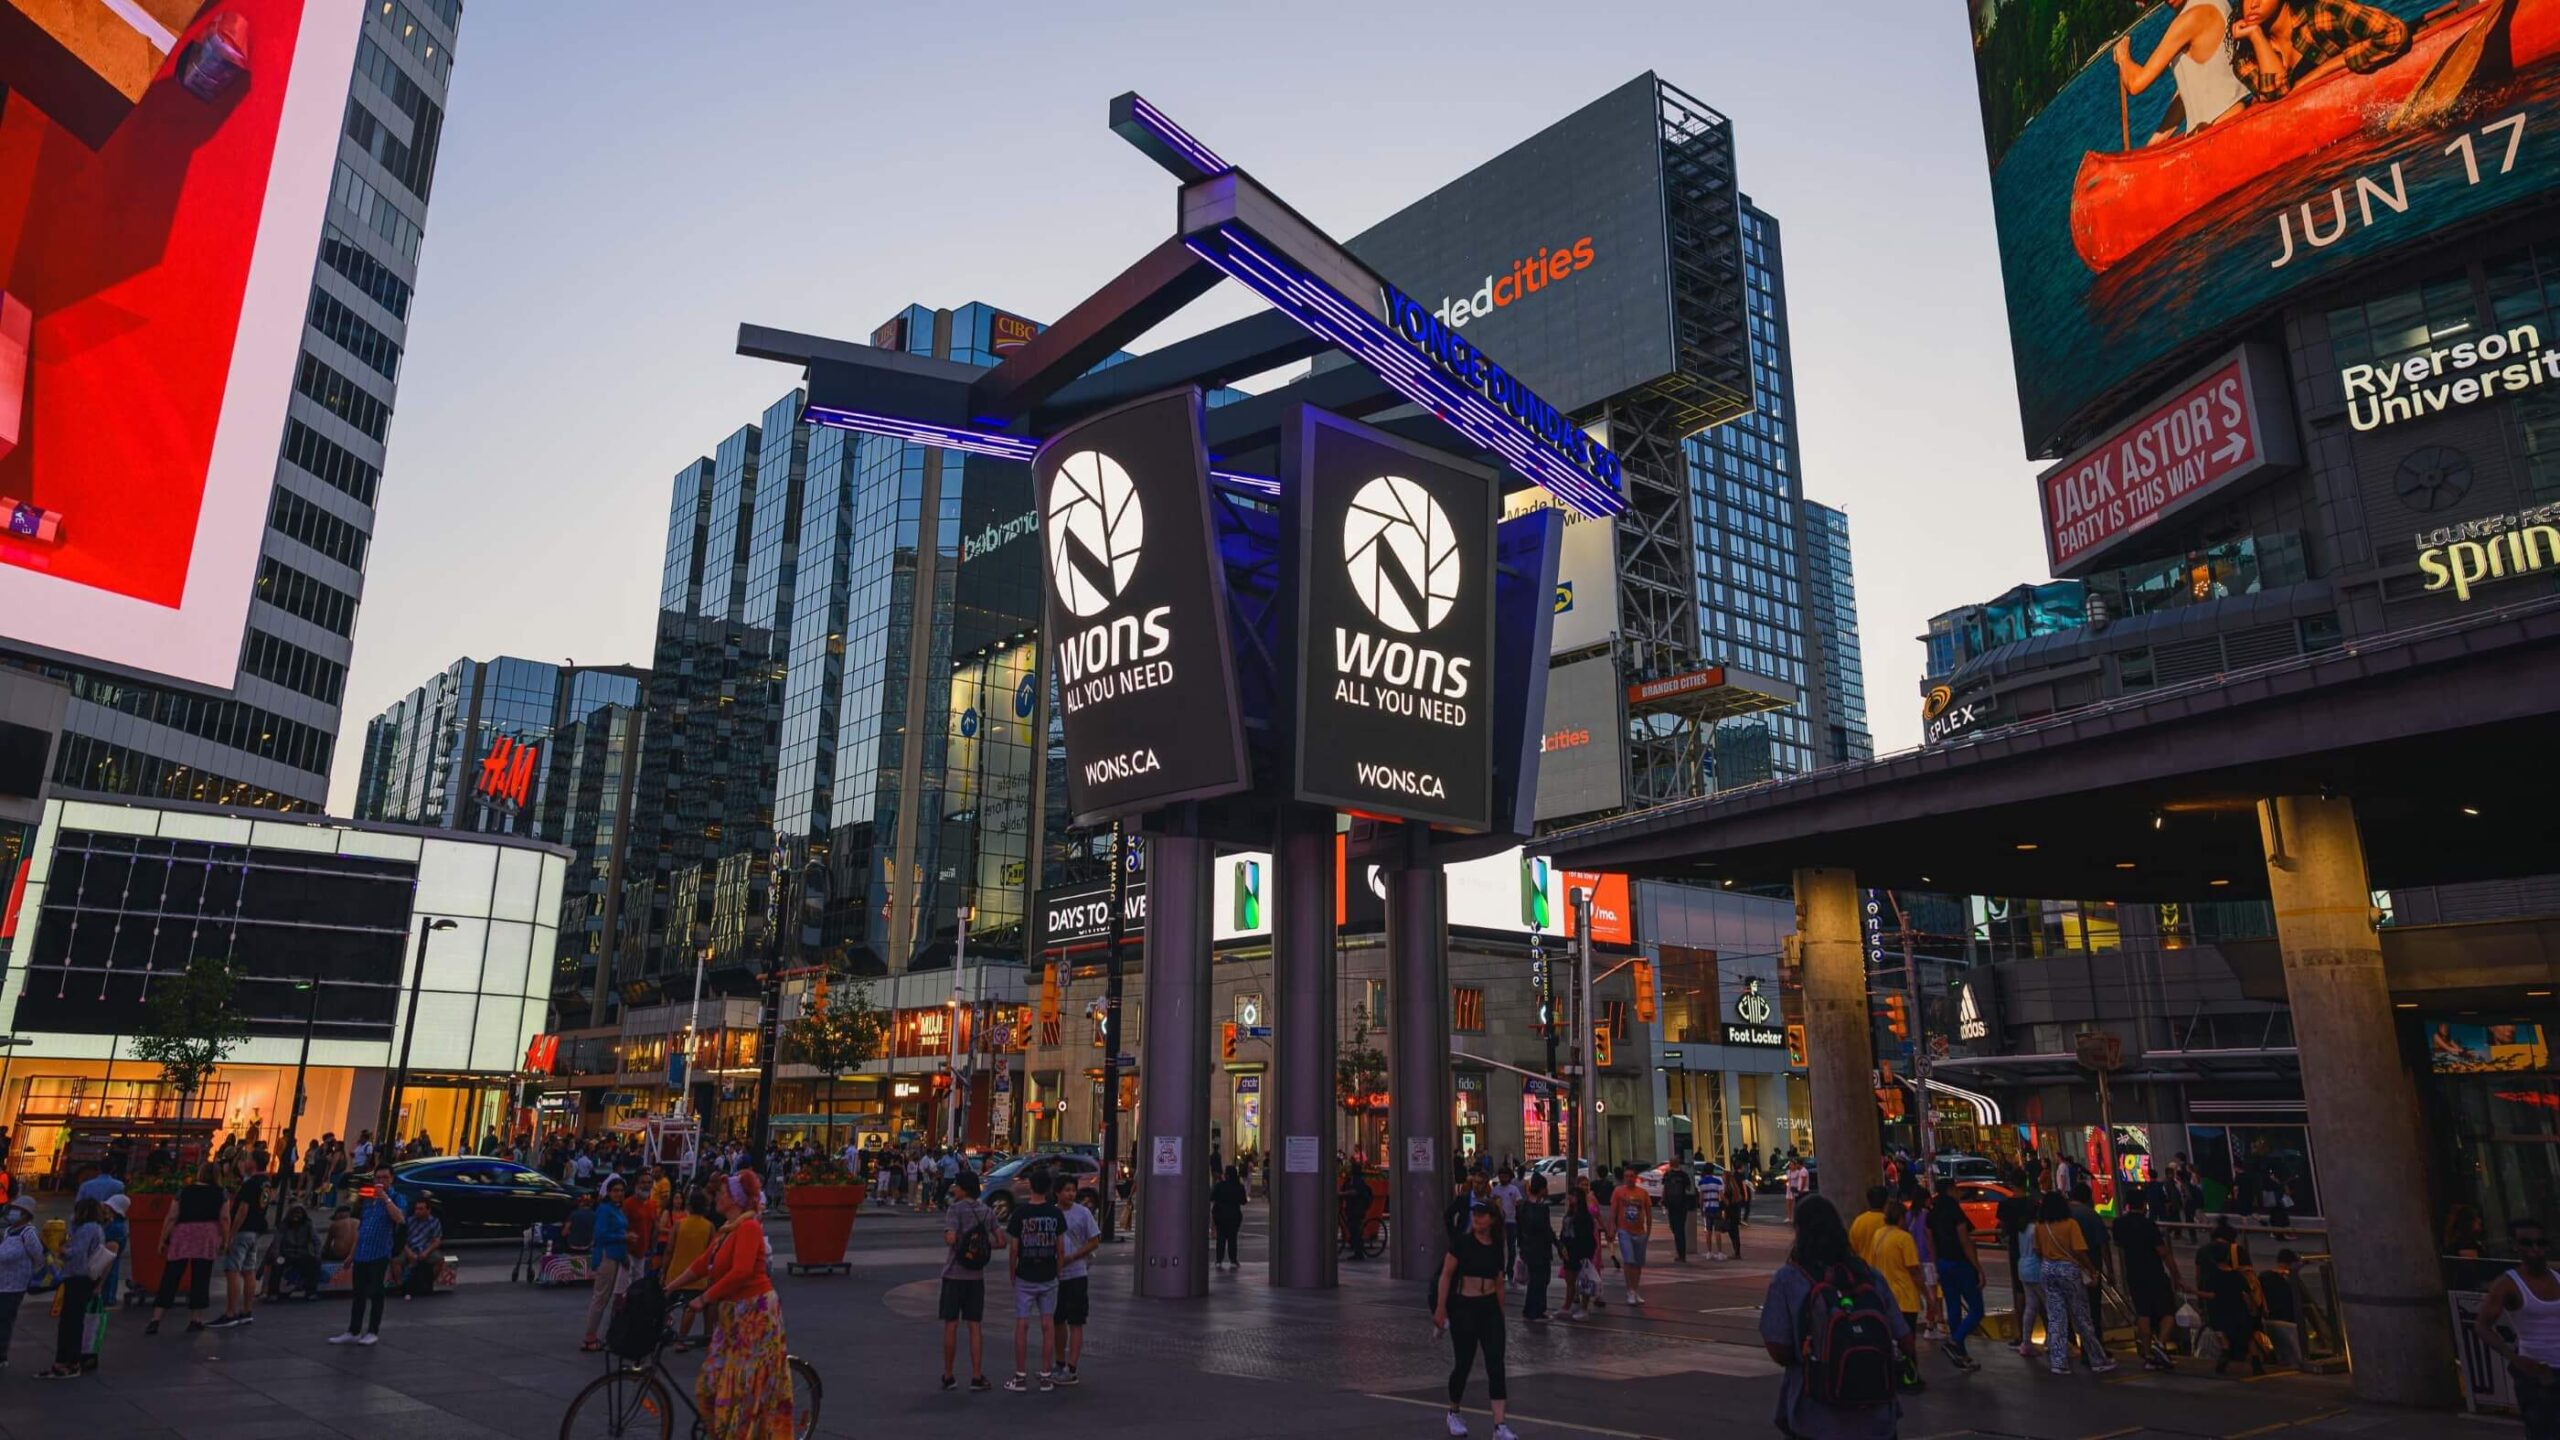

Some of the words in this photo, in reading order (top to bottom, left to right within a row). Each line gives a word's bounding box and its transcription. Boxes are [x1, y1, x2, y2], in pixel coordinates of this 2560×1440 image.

[2271, 161, 2409, 269] JUN
[2445, 112, 2527, 186] 17
[998, 317, 1036, 342] CIBC
[2341, 324, 2540, 400] Ryerson
[2347, 349, 2560, 431] Universit
[2055, 452, 2116, 529] JACK
[2121, 378, 2242, 490] ASTOR'S
[2058, 508, 2106, 558] PARTY
[2108, 500, 2125, 530] IS
[2125, 476, 2165, 519] THIS
[2166, 450, 2207, 497] WAY
[1067, 689, 1084, 715] ALL
[1084, 674, 1114, 705] YOU
[1119, 660, 1174, 695] NEED
[1335, 678, 1370, 707] ALL
[1375, 686, 1413, 716] YOU
[1420, 697, 1467, 727] NEED
[1642, 680, 1679, 698] BRANDED
[1680, 673, 1707, 690] CITIES
[1085, 747, 1161, 787] WONS.CA
[1357, 761, 1446, 800] WONS.CA
[1048, 905, 1085, 933] DAYS
[1087, 901, 1109, 926] TO
[1530, 920, 1541, 987] Yonge
[921, 1014, 943, 1036] MUJI
[1729, 1027, 1750, 1043] Foot
[1751, 1030, 1783, 1045] Locker
[1458, 1077, 1475, 1090] fido
[1022, 1216, 1058, 1233] ASTRO
